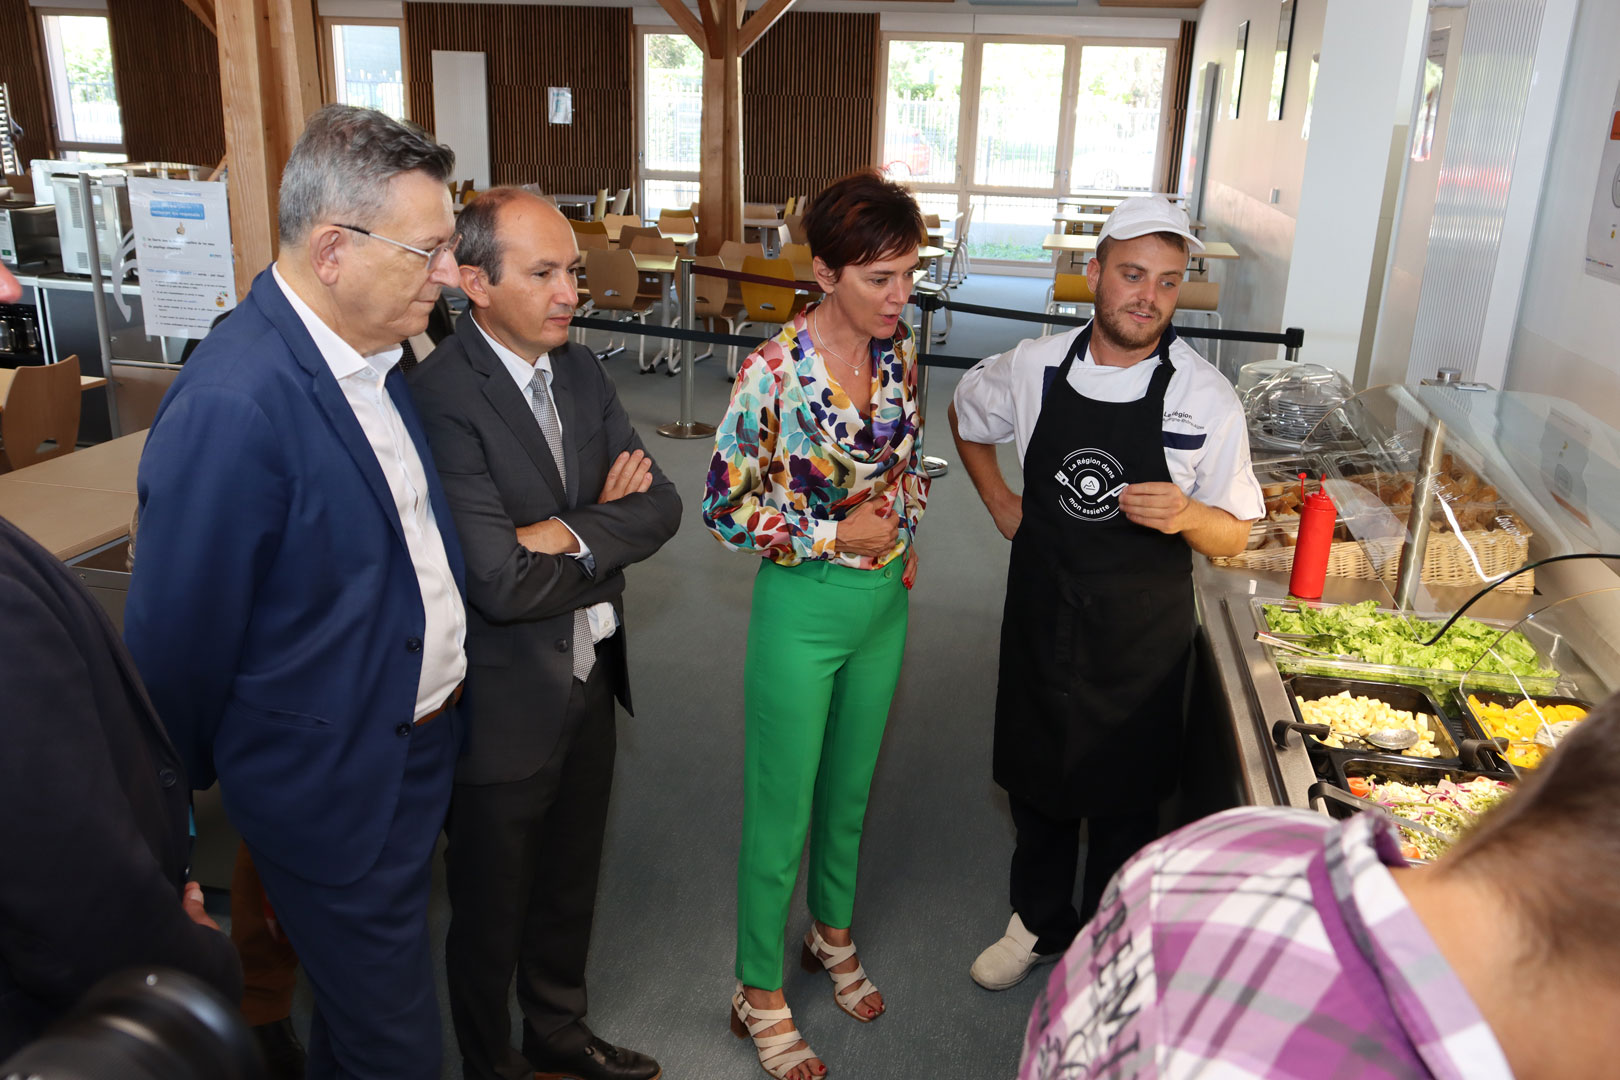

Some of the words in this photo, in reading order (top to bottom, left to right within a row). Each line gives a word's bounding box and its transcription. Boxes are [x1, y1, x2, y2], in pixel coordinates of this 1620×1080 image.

[1068, 463, 1077, 472] La
[1076, 457, 1101, 466] Région
[1101, 463, 1115, 479] dans
[1068, 497, 1082, 511] mon
[1082, 504, 1110, 515] assiette
